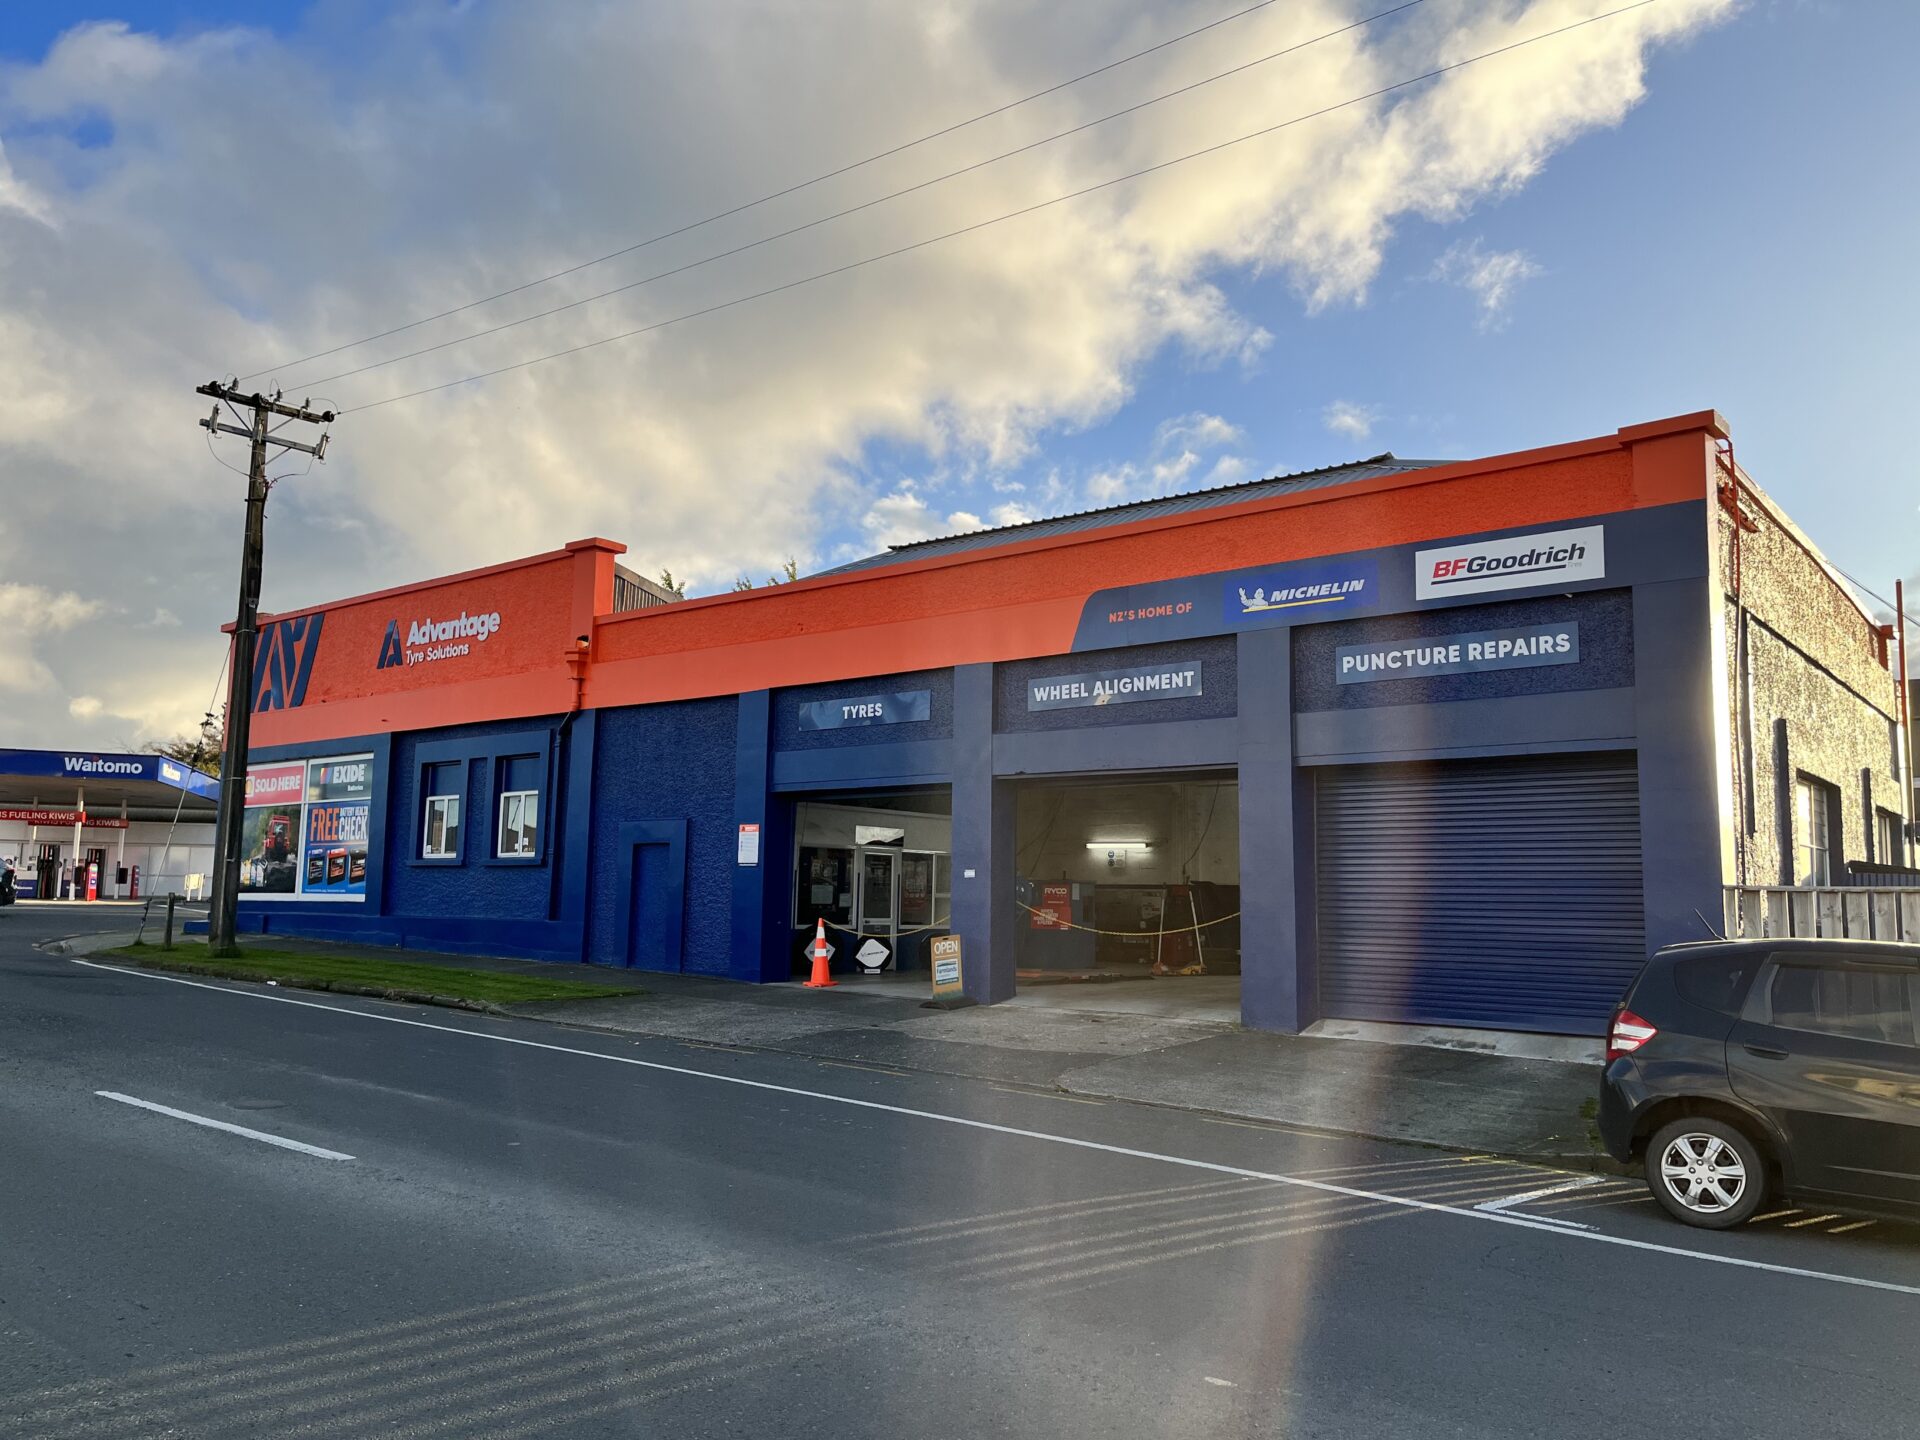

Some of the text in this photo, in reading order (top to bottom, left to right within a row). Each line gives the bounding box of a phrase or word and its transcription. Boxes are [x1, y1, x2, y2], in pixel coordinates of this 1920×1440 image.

[1432, 543, 1586, 579] BFGoodrich
[1270, 579, 1365, 603] MICHELIN
[1108, 602, 1193, 623] NZ'S HOME OF
[406, 611, 500, 647] Advantage
[406, 643, 469, 667] Tyre Solutions
[1342, 633, 1571, 673] PUNCTURE REPAIRS
[1033, 671, 1195, 703] WHEEL ALIGNMENT
[842, 702, 883, 720] TYRES
[64, 757, 142, 774] Waitomo
[332, 764, 366, 784] EXIDE
[255, 775, 300, 793] SOLD HERE
[9, 811, 47, 820] FUELING
[48, 812, 75, 820] KIWIS
[310, 807, 340, 842] FREE
[338, 815, 368, 841] CHECK
[1044, 887, 1067, 895] RYCO
[934, 940, 958, 954] OPEN
